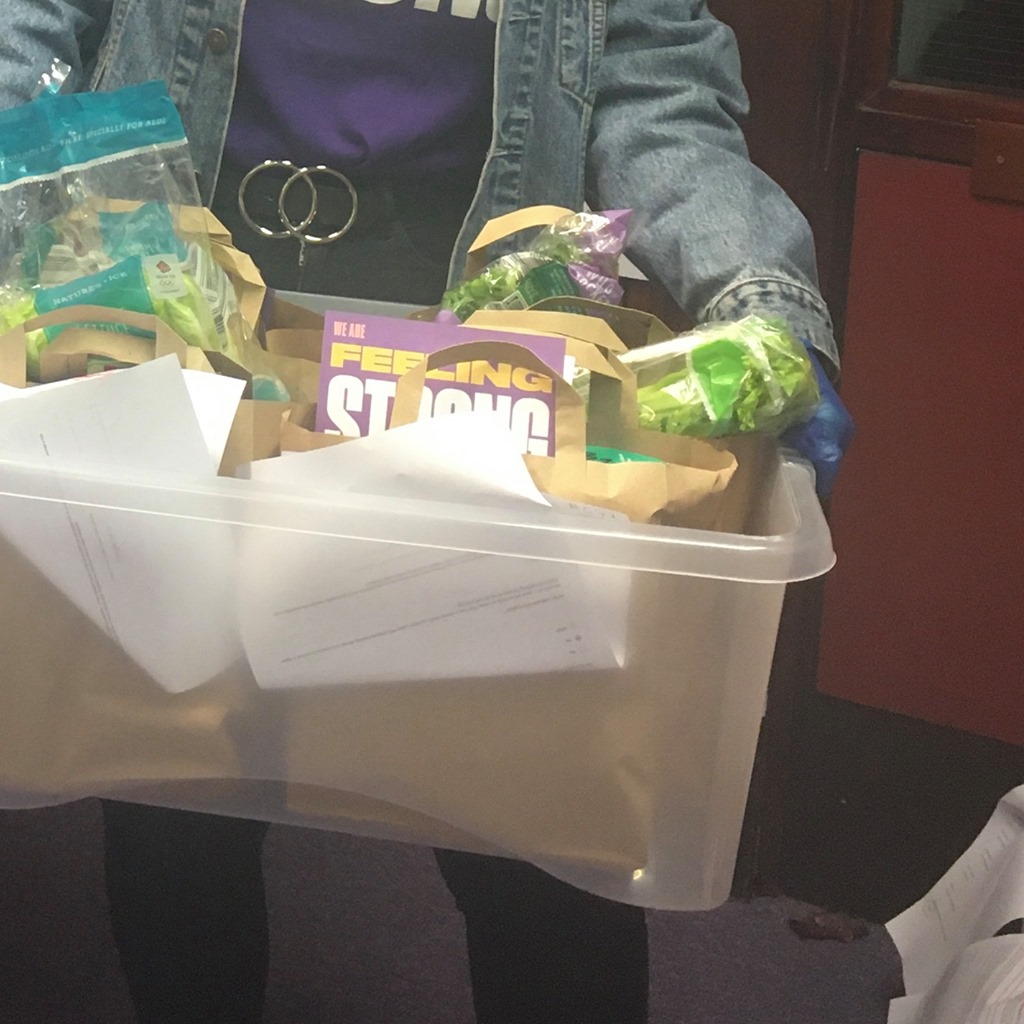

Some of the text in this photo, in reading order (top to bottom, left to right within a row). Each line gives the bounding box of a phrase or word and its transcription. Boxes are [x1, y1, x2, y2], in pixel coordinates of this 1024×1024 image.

[333, 321, 366, 339] WE ARE
[323, 373, 551, 457] STG
